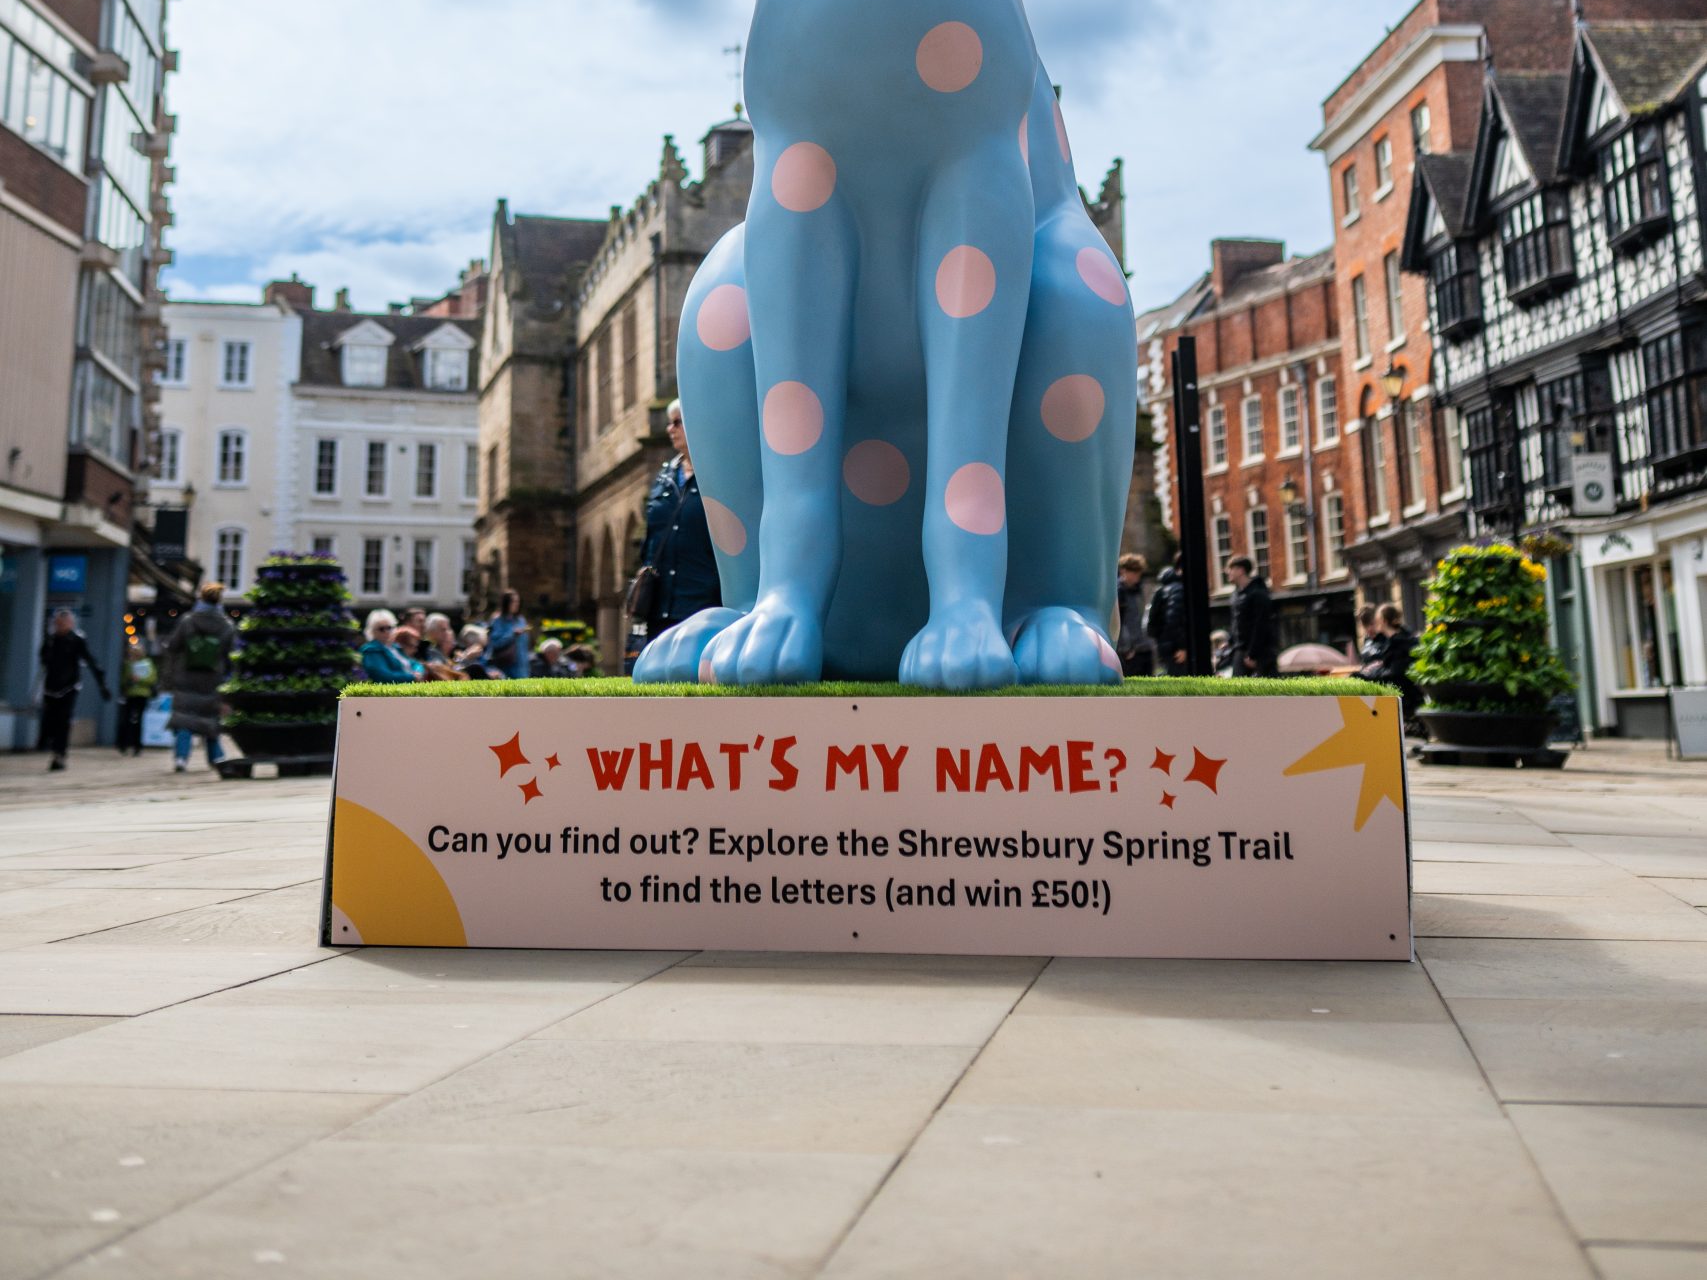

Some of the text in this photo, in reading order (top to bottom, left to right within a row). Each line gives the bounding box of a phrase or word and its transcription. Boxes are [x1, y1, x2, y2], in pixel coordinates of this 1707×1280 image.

[586, 734, 1127, 793] WHAT'S MY NAME?
[427, 824, 1295, 868] Can you find out? Explore the Shrewsbury Spring Trail
[599, 874, 1112, 916] to find the letters (and win £50!)
